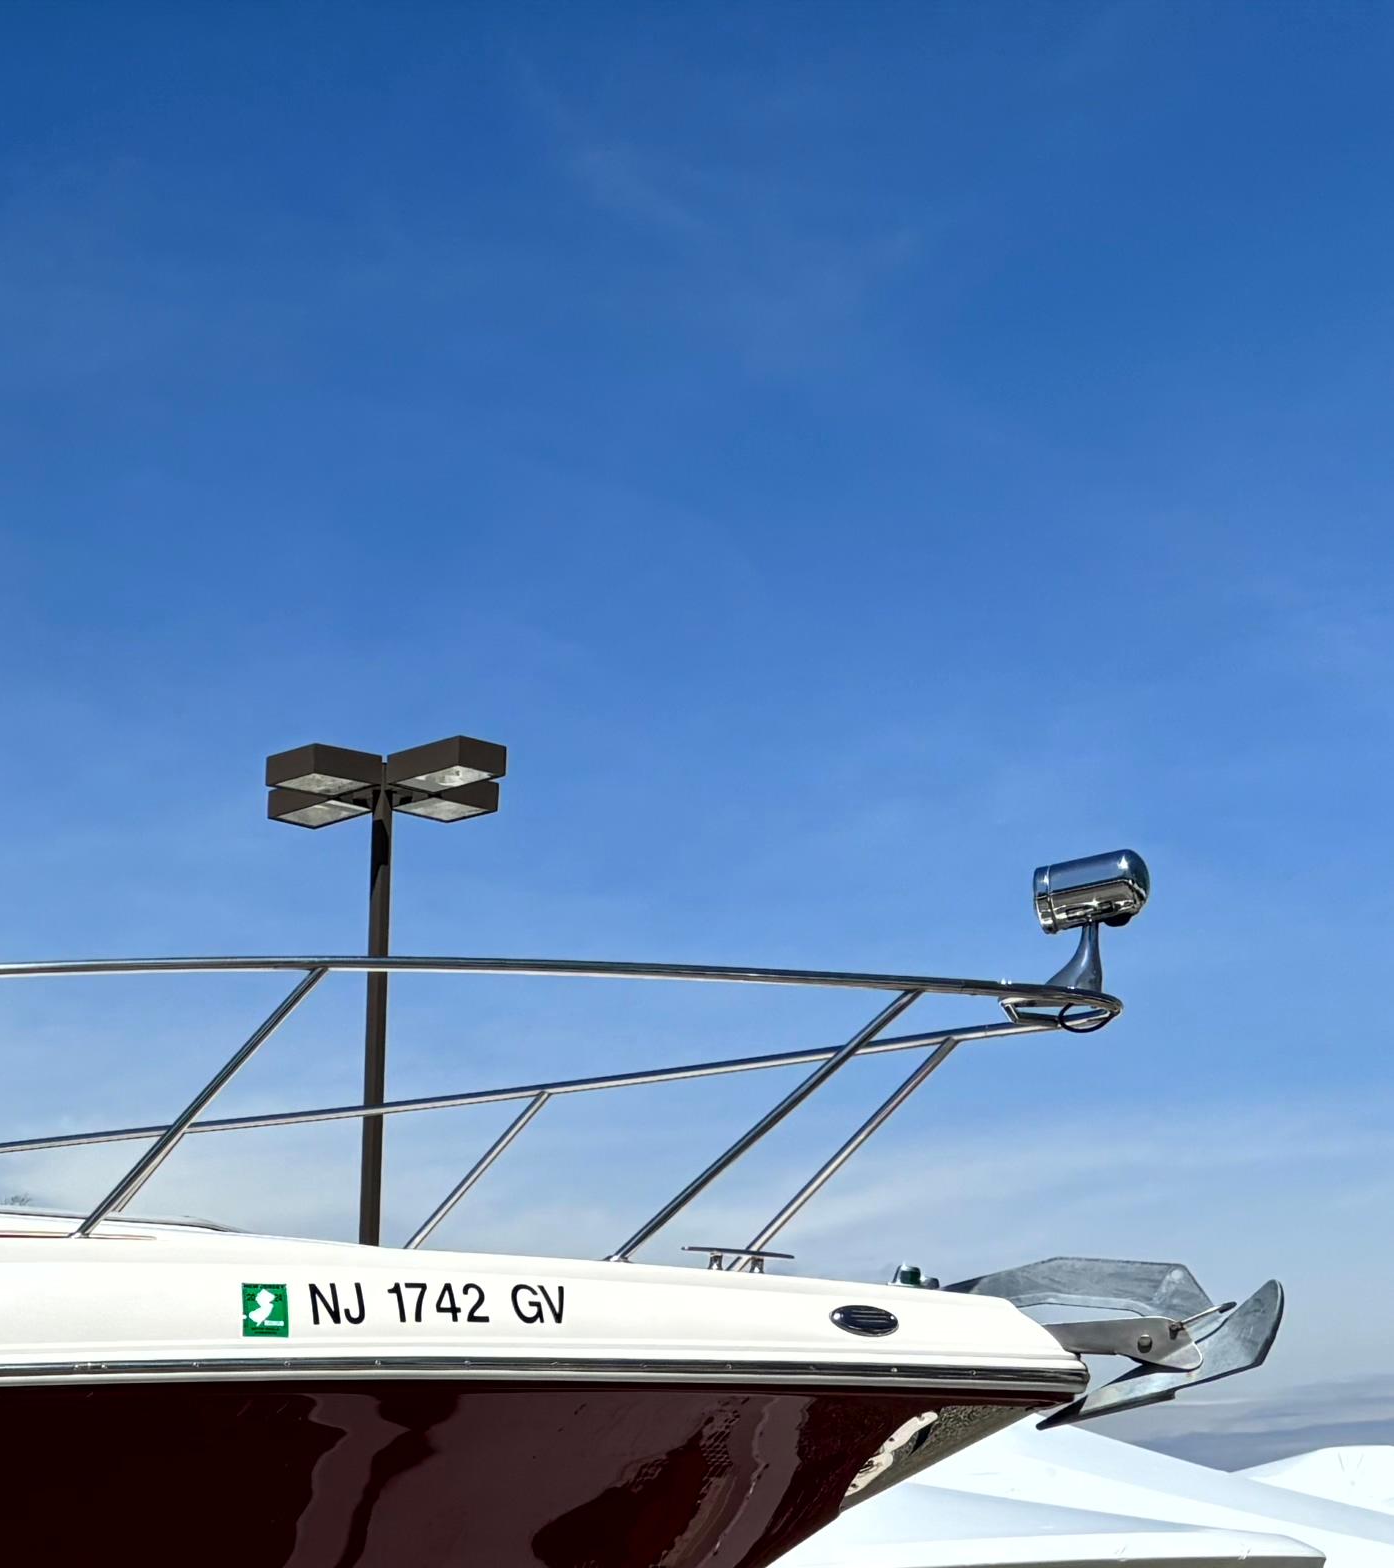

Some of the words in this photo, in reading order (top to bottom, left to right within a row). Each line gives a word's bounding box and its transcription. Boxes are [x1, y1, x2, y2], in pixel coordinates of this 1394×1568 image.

[308, 1282, 366, 1325] NJ
[387, 1282, 490, 1323] 1742
[511, 1284, 564, 1324] GV
